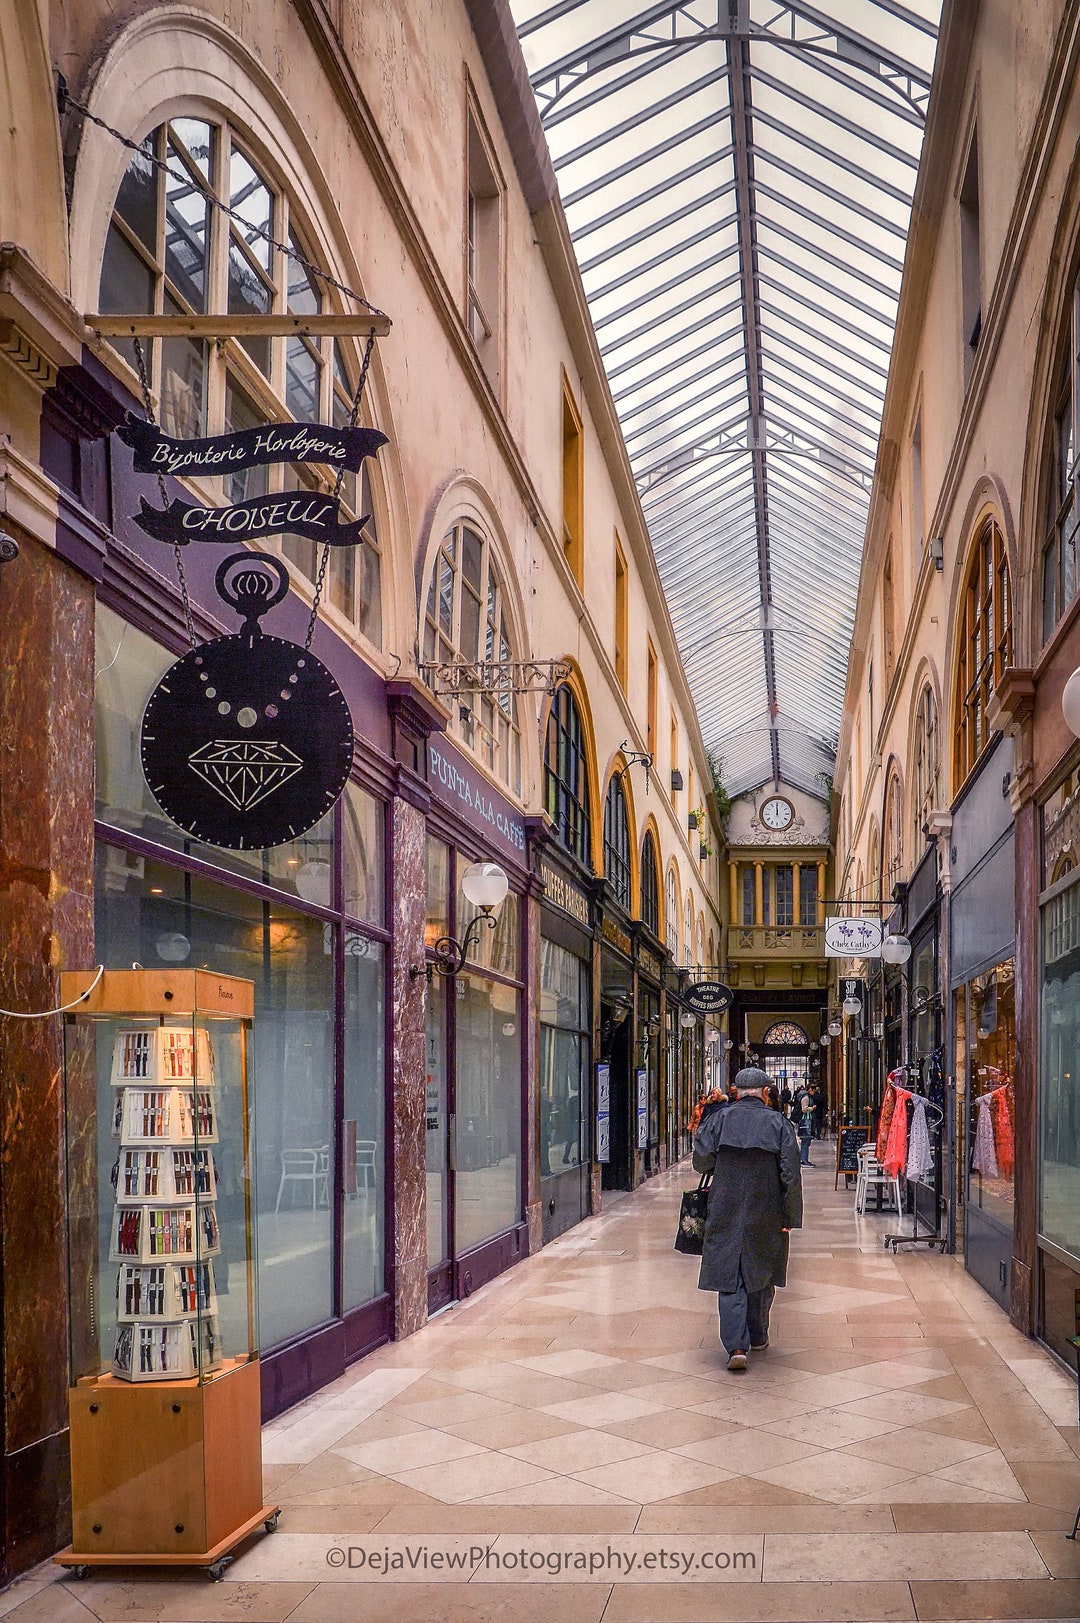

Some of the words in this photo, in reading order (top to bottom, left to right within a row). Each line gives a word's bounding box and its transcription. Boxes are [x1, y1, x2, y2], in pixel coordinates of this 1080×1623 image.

[151, 443, 247, 473] Bijouterie
[255, 428, 348, 460] Horlogerie
[182, 500, 333, 532] CHOISEUL
[429, 746, 473, 808] PUNTA
[832, 940, 850, 948] Chez
[845, 981, 857, 994] SIP
